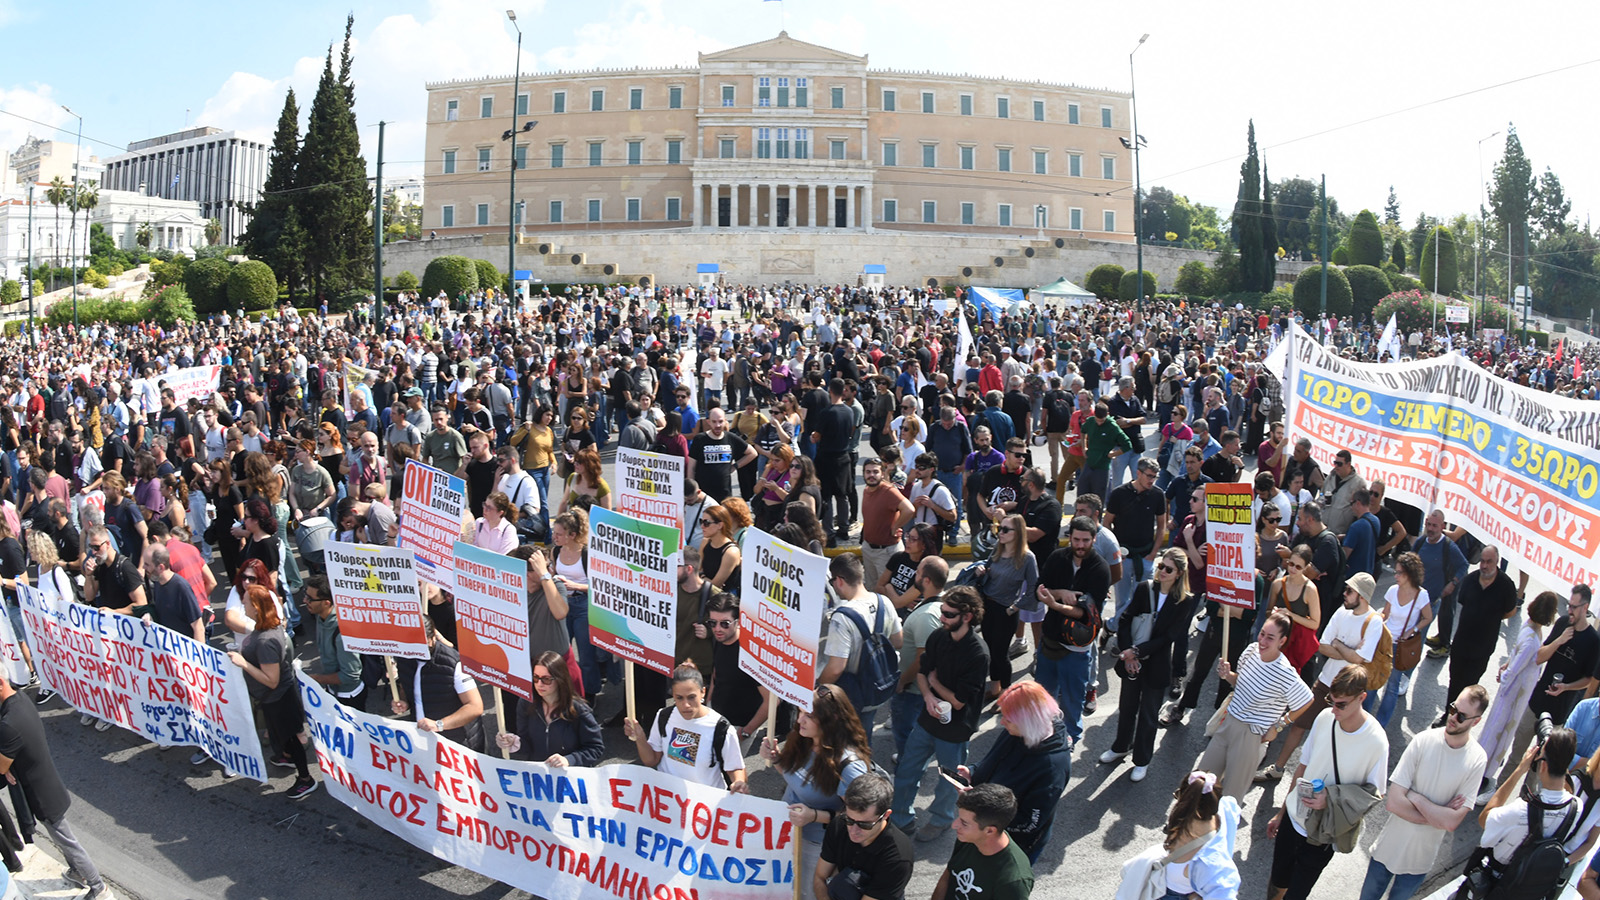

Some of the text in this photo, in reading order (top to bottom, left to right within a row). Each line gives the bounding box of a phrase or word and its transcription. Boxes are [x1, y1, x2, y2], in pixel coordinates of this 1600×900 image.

[1377, 372, 1399, 390] ΤΟ
[1483, 377, 1504, 415] ΤΗΣ
[1303, 374, 1371, 416] 7ΩΡΟ
[1390, 401, 1491, 451] 5ΗΜΕΡΟ
[1511, 436, 1598, 499] 35ΩΡΟ
[618, 453, 680, 472] 13ωρες ΔΟΥΛΕΙΑ
[627, 467, 670, 483] ΤΣΑΚΙΖΟΥΝ
[1301, 408, 1592, 550] ΑΥΞΗΣΕΙΣ ΣΤΟΥΣ ΜΙΣΘΟΥΣ
[404, 463, 434, 507] ΟΧΙ
[433, 485, 461, 505] 13 ΩΡΕΣ
[434, 473, 449, 487] ΣΤΙΣ
[625, 478, 672, 495] ΤΗ ΖΩΗ ΜΑΣ
[431, 498, 461, 518] ΔΟΥΛΕΙΑ
[622, 495, 677, 518] ΟΡΓΑΝΩΣΗ
[1235, 508, 1251, 524] ΖΩΗ
[597, 523, 660, 556] ΦΕΡΝΟΥΝ ΣΕ
[1214, 530, 1244, 544] ΟΡΓΑΝΩΣΟΥ
[1444, 491, 1522, 553] ΥΠΑΛΛΗΛΩΝ
[1524, 540, 1598, 595] ΕΛΛΑΔΑΣ
[328, 551, 412, 569] 13ωρες ΔΟΥΛΕΙΑ
[590, 536, 668, 573] ΑΝΤΙΠΑΡΑΘΕΣΗ
[755, 545, 804, 587] 13ωρες
[1215, 544, 1243, 569] ΤΩΡΑ
[334, 579, 370, 591] ΔΕΥΤΕΡΑ
[376, 583, 416, 595] ΚΥΡΙΑΚΗ
[343, 567, 371, 579] ΒΡΑΔΥ
[378, 571, 401, 581] ΠΡΩΙ
[455, 557, 496, 580] ΜΗΤΡΟΤΗΤΑ
[501, 571, 523, 588] ΥΓΕΙΑ
[590, 556, 633, 584] ΜΗΤΡΟΤΗΤΑ
[640, 573, 674, 597] ΕΡΓΑΣΙΑ,
[1207, 565, 1215, 575] ΓΙΑ
[1224, 569, 1252, 582] ΑΝΑΤΡΟΠΗ
[336, 595, 418, 612] ΔΕΝ ΘΑ ΣΑΣ ΠΕΡΑΣΕΙ
[457, 574, 522, 607] ΣΤΑΘΕΡΗ ΔΟΥΛΕΙΑ,
[591, 576, 649, 609] ΚΥΒΕΡΝΗΣΗ
[659, 601, 671, 616] ΕΕ
[753, 571, 801, 612] ΔΟΥΛΕΙΑ
[338, 607, 421, 628] ΕΧΟΥΜΕ ΖΩΗ
[458, 600, 526, 634] ΔΕΝ ΤΑ ΘΥΣΙΑΖΟΥΜΕ
[594, 591, 669, 630] ΚΑΙ ΕΡΓΟΔΟΣΙΑ
[759, 603, 791, 636] Ποιός
[16, 582, 35, 608] ΓΙΑ
[69, 604, 107, 635] ΟΥΤΕ
[113, 615, 134, 641] ΤΟ
[142, 622, 226, 676] ΣΥΖΗΤΑΜΕ
[462, 616, 523, 649] ΓΙΑ ΤΑ ΑΦΕΝΤΙΚΑ
[741, 612, 813, 666] θα μεγαλώνει
[24, 609, 40, 633] ΓΙΑ
[42, 617, 100, 657] ΑΥΞΗΣΕΙΣ
[100, 637, 147, 672] ΣΤΟΥΣ
[152, 652, 229, 704] ΜΙΣΘΟΥΣ
[748, 639, 799, 681] τα παιδιά;
[33, 632, 77, 673] ΣΤΑΘΕΡΟ
[78, 656, 126, 689] ΩΡΑΡΙΟ
[148, 676, 228, 732] ΑΣΦΑΛΕΙΑ
[56, 669, 141, 731] ΠΟΛΕΜΑΜΕ
[166, 722, 260, 778] ΣΚΛΑΒΕΝΙΤΗ
[297, 680, 322, 708] ΤΟ
[436, 741, 485, 784] ΔΕΝ
[496, 768, 588, 804] ΕΙΝΑΙ
[609, 778, 791, 850] ΕΛΕΥΘΕΡΙΑ
[305, 711, 355, 760] ΕΙΝΑΙ
[369, 743, 499, 813] ΕΡΓΑΛΕΙΟ
[506, 801, 551, 832] ΓΙΑ
[563, 813, 626, 847] ΤΗΝ
[315, 749, 427, 826] ΣΥΛΛΟΓΟΣ
